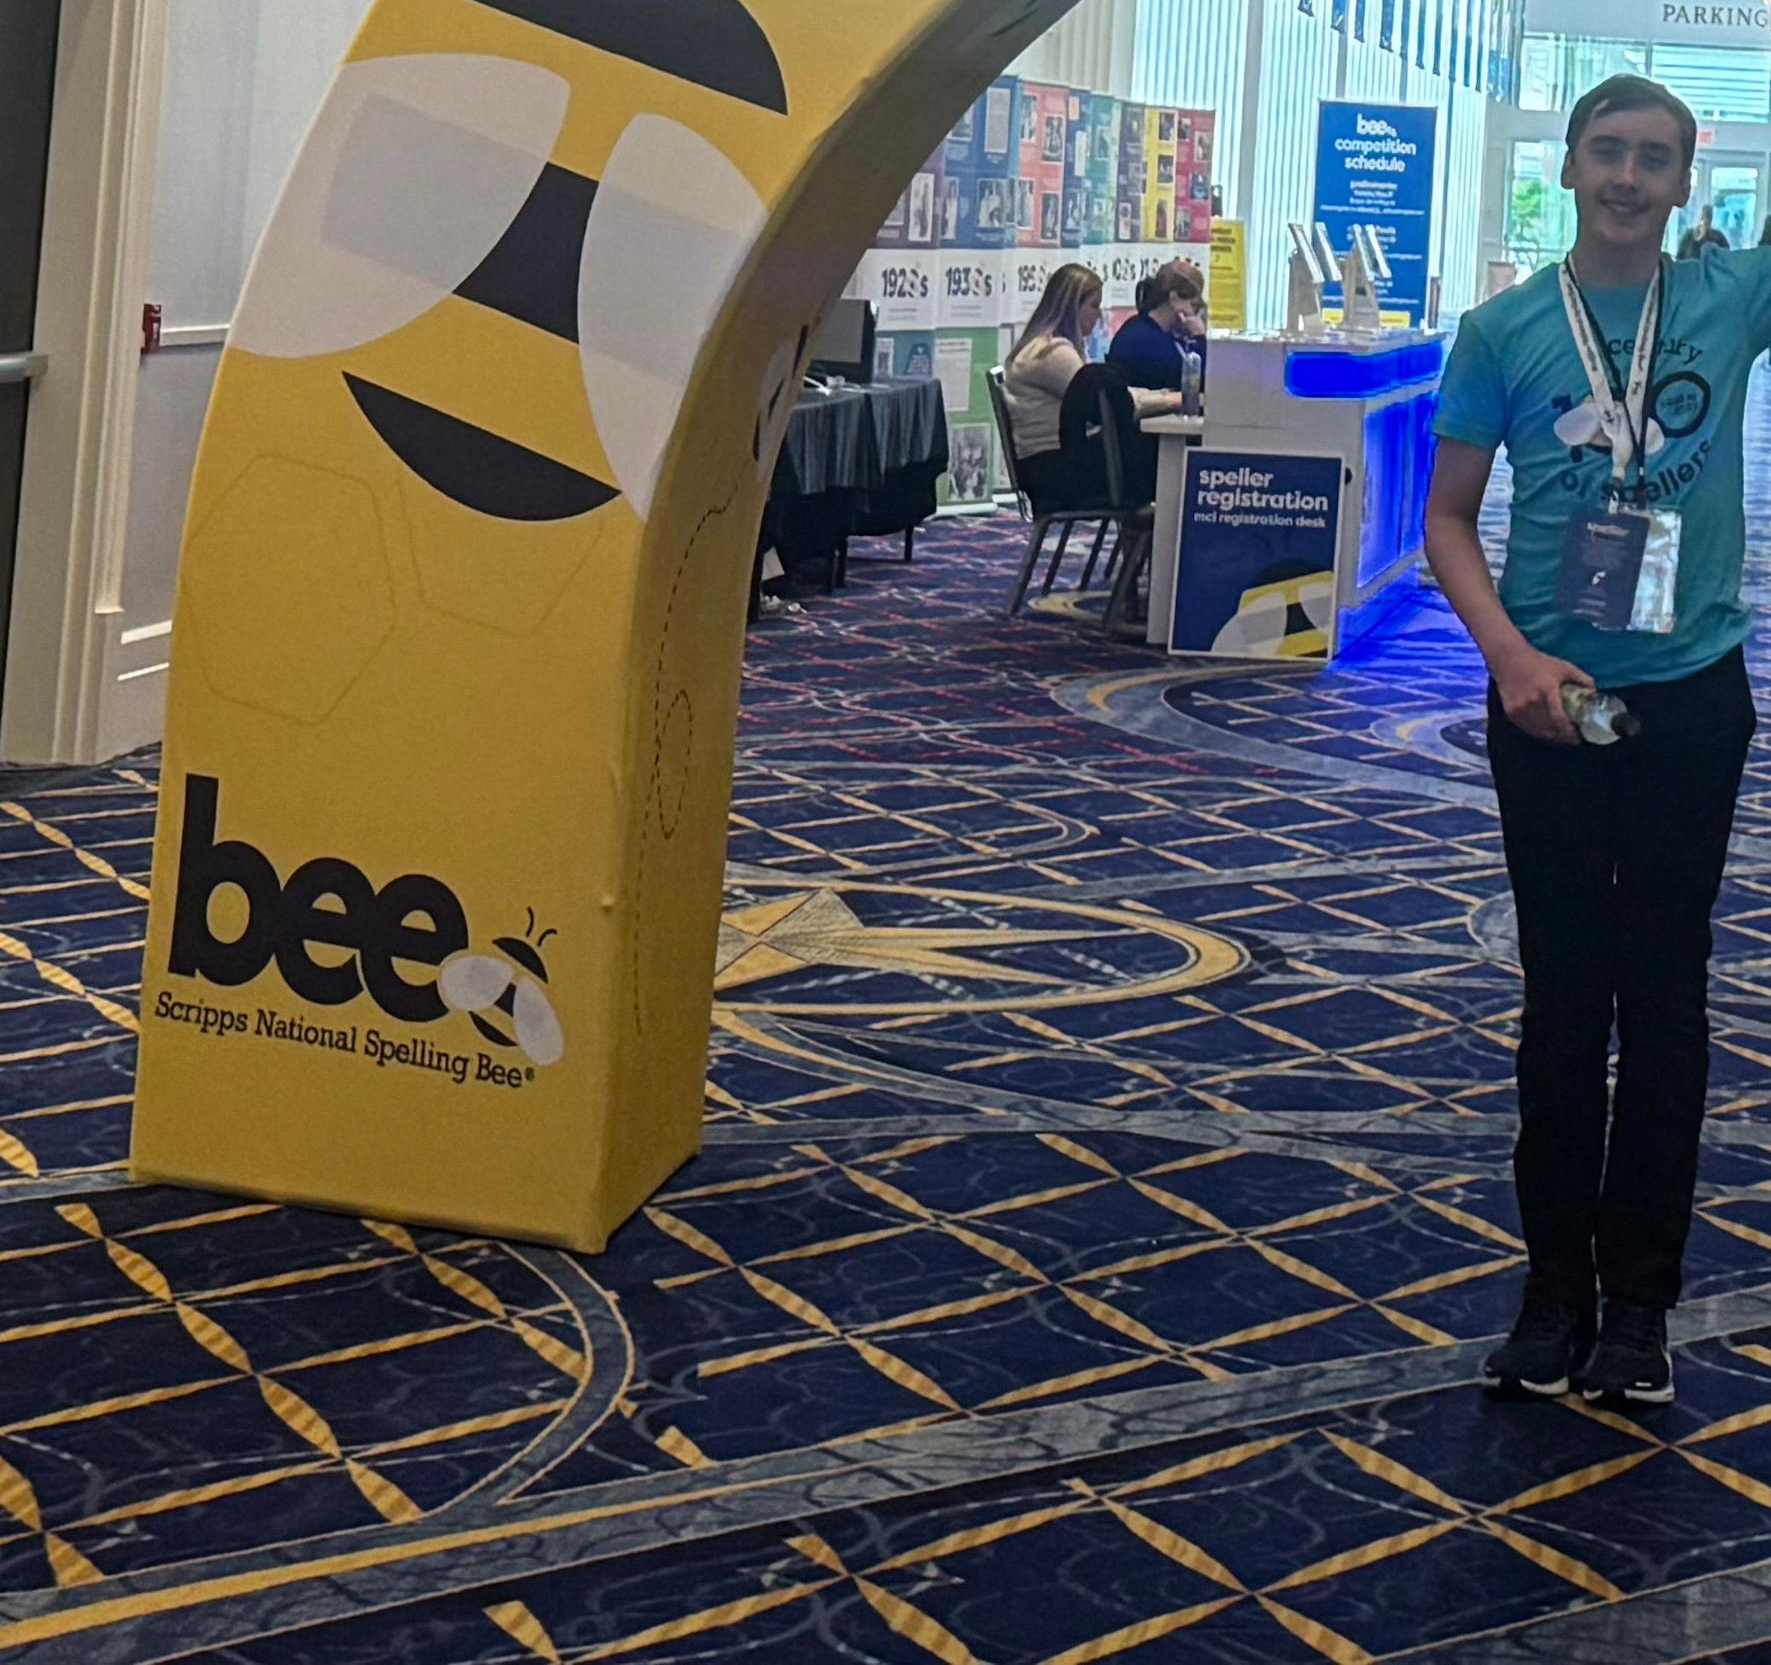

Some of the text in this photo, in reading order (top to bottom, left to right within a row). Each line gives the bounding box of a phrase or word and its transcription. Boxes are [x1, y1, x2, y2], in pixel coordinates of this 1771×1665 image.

[1663, 3, 1768, 28] PARKING
[1335, 138, 1417, 155] competition
[1345, 155, 1405, 172] schedule
[1199, 468, 1274, 488] speller
[1198, 489, 1329, 511] registration
[1219, 513, 1293, 526] registration
[1296, 516, 1326, 528] desk
[168, 773, 469, 1023] bee
[155, 991, 248, 1035] Scripps
[256, 1009, 357, 1053] National
[364, 1030, 469, 1083] Spelling
